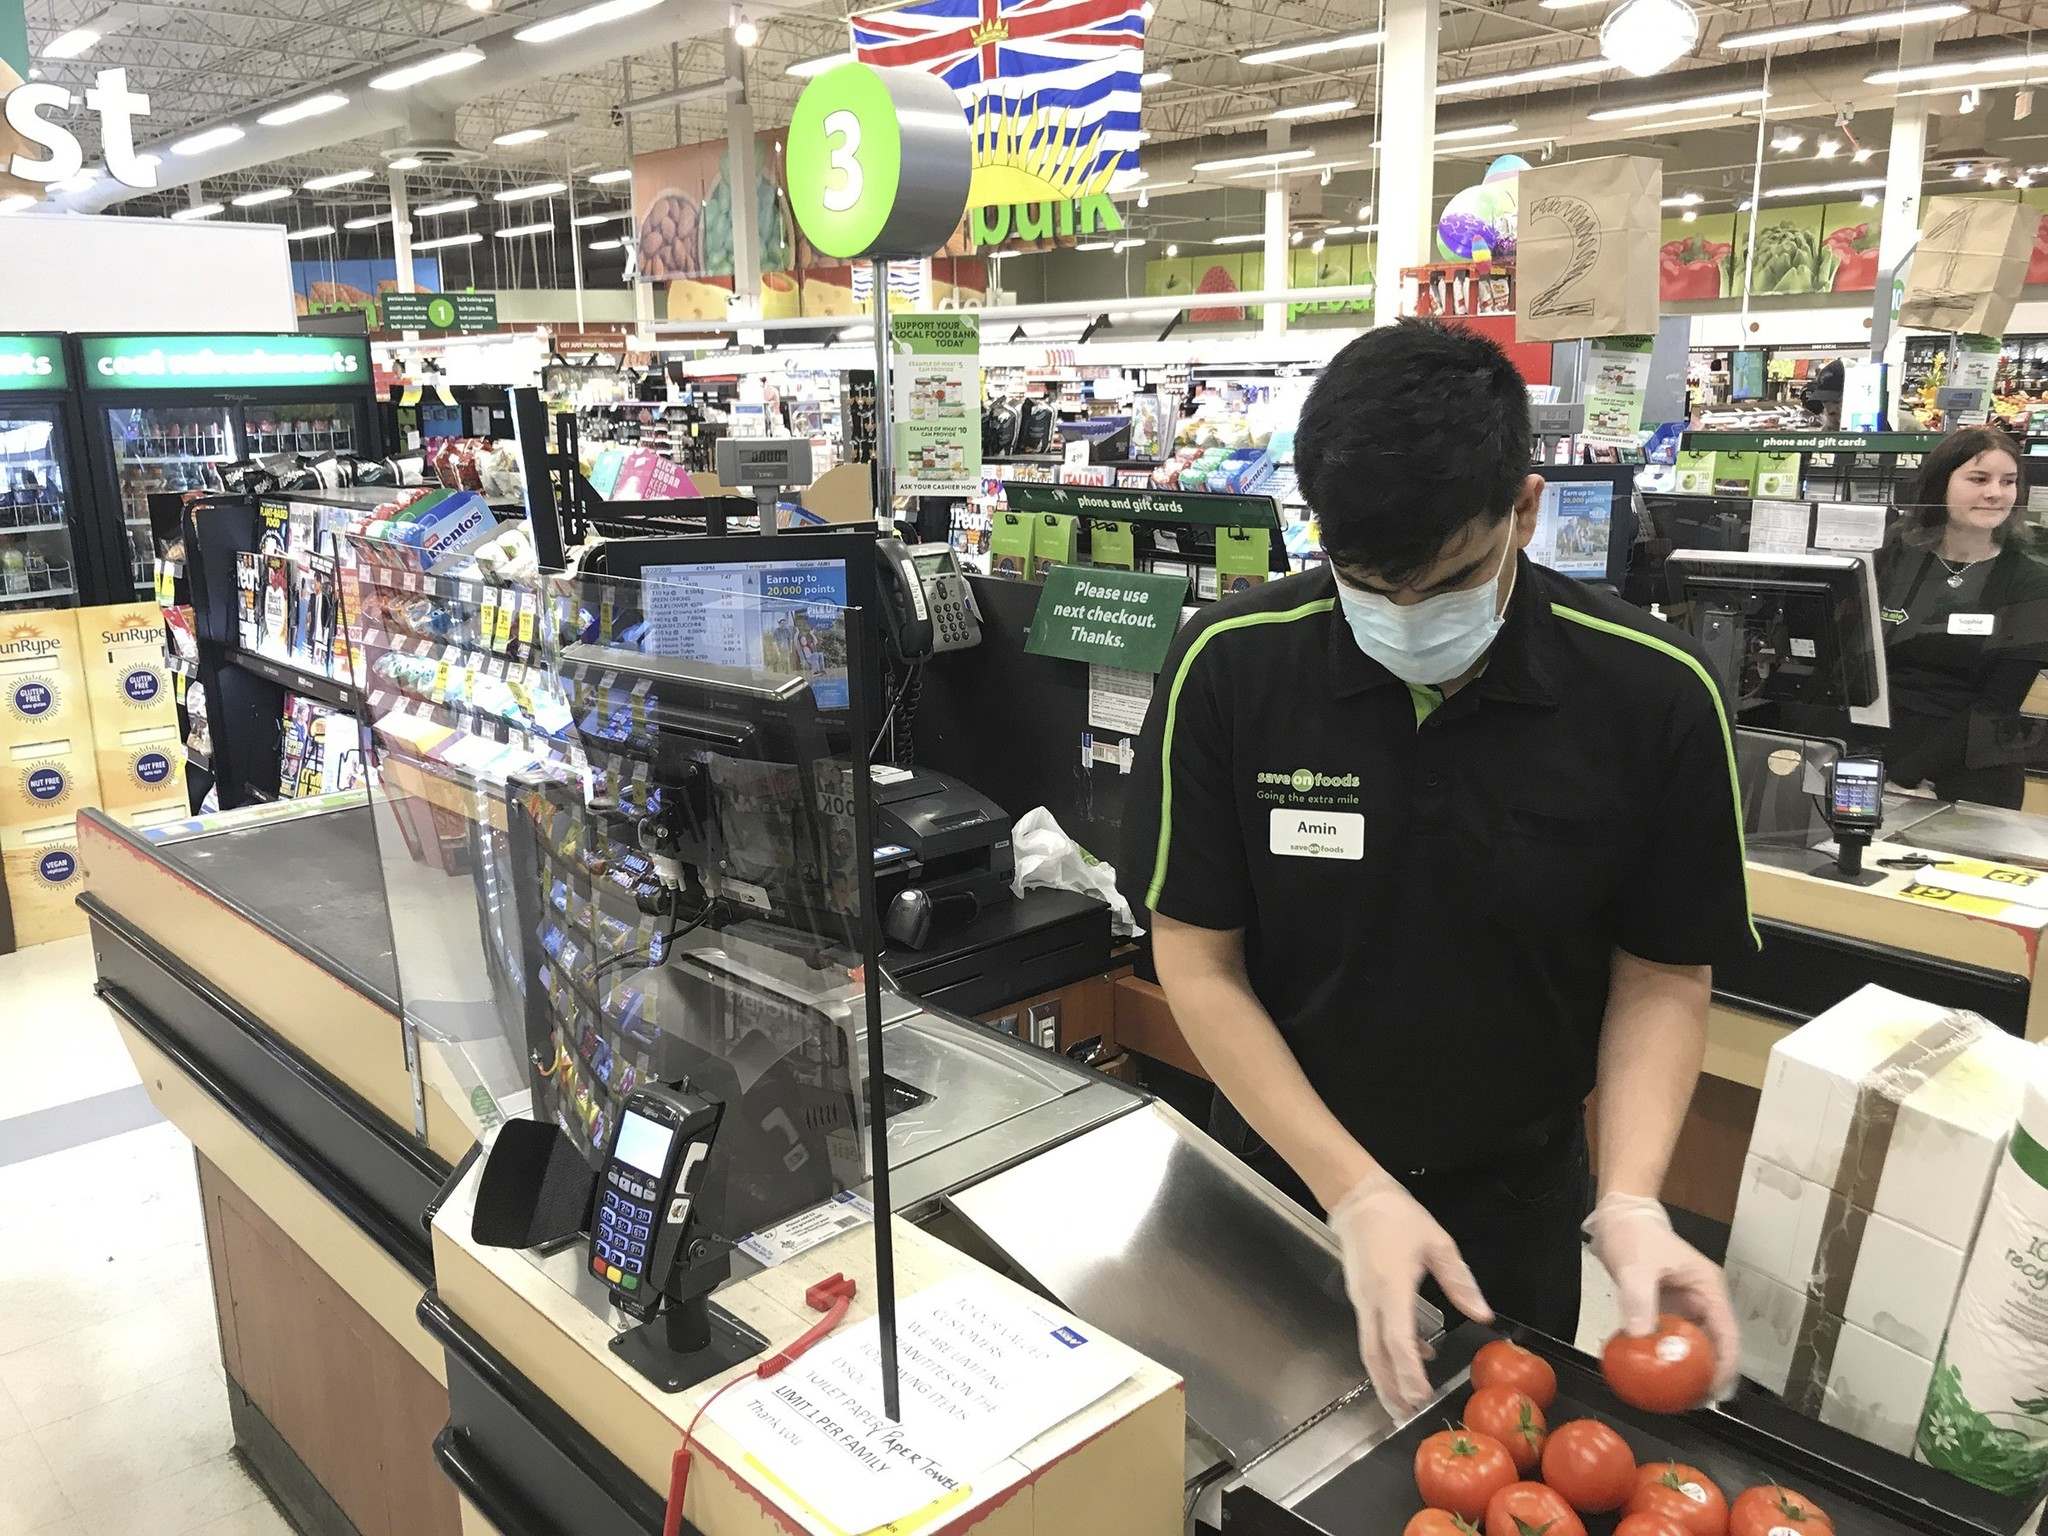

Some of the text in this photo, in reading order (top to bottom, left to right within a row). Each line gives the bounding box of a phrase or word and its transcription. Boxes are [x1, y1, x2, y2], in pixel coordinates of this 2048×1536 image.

[821, 110, 864, 212] 3
[1528, 195, 1601, 320] 2
[438, 305, 446, 321] 1
[895, 321, 960, 330] SUPPORT YOUR
[895, 330, 977, 339] LOCAL FOOD BANK
[935, 340, 964, 348] TODAY
[1763, 437, 1866, 449] phone and gift cards
[652, 468, 681, 489] SUGAR
[1063, 474, 1104, 486] ITALIAN
[1078, 495, 1183, 514] phone and gift cards
[428, 511, 483, 561] mentos
[767, 574, 817, 585] Earn up to
[767, 586, 802, 596] 20,000
[804, 585, 836, 595] points
[1074, 581, 1149, 604] Please use
[1053, 603, 1157, 629] next checkout.
[102, 627, 165, 644] SunRype
[1070, 626, 1126, 648] Thanks.
[129, 675, 152, 685] GLUTEN
[134, 681, 149, 689] FREE
[20, 688, 45, 697] GLUTEN
[25, 693, 41, 702] FREE
[138, 762, 166, 771] NUT FREE
[30, 776, 60, 788] NUT FREE
[1256, 772, 1360, 787] save on foods
[1256, 790, 1359, 804] Going the extra mile
[1297, 821, 1337, 835] Amin
[1321, 844, 1344, 853] foods
[46, 859, 68, 869] VEGAN
[747, 1398, 782, 1429] Thank
[775, 1385, 892, 1473] LIMIT 1 PER FAMILY
